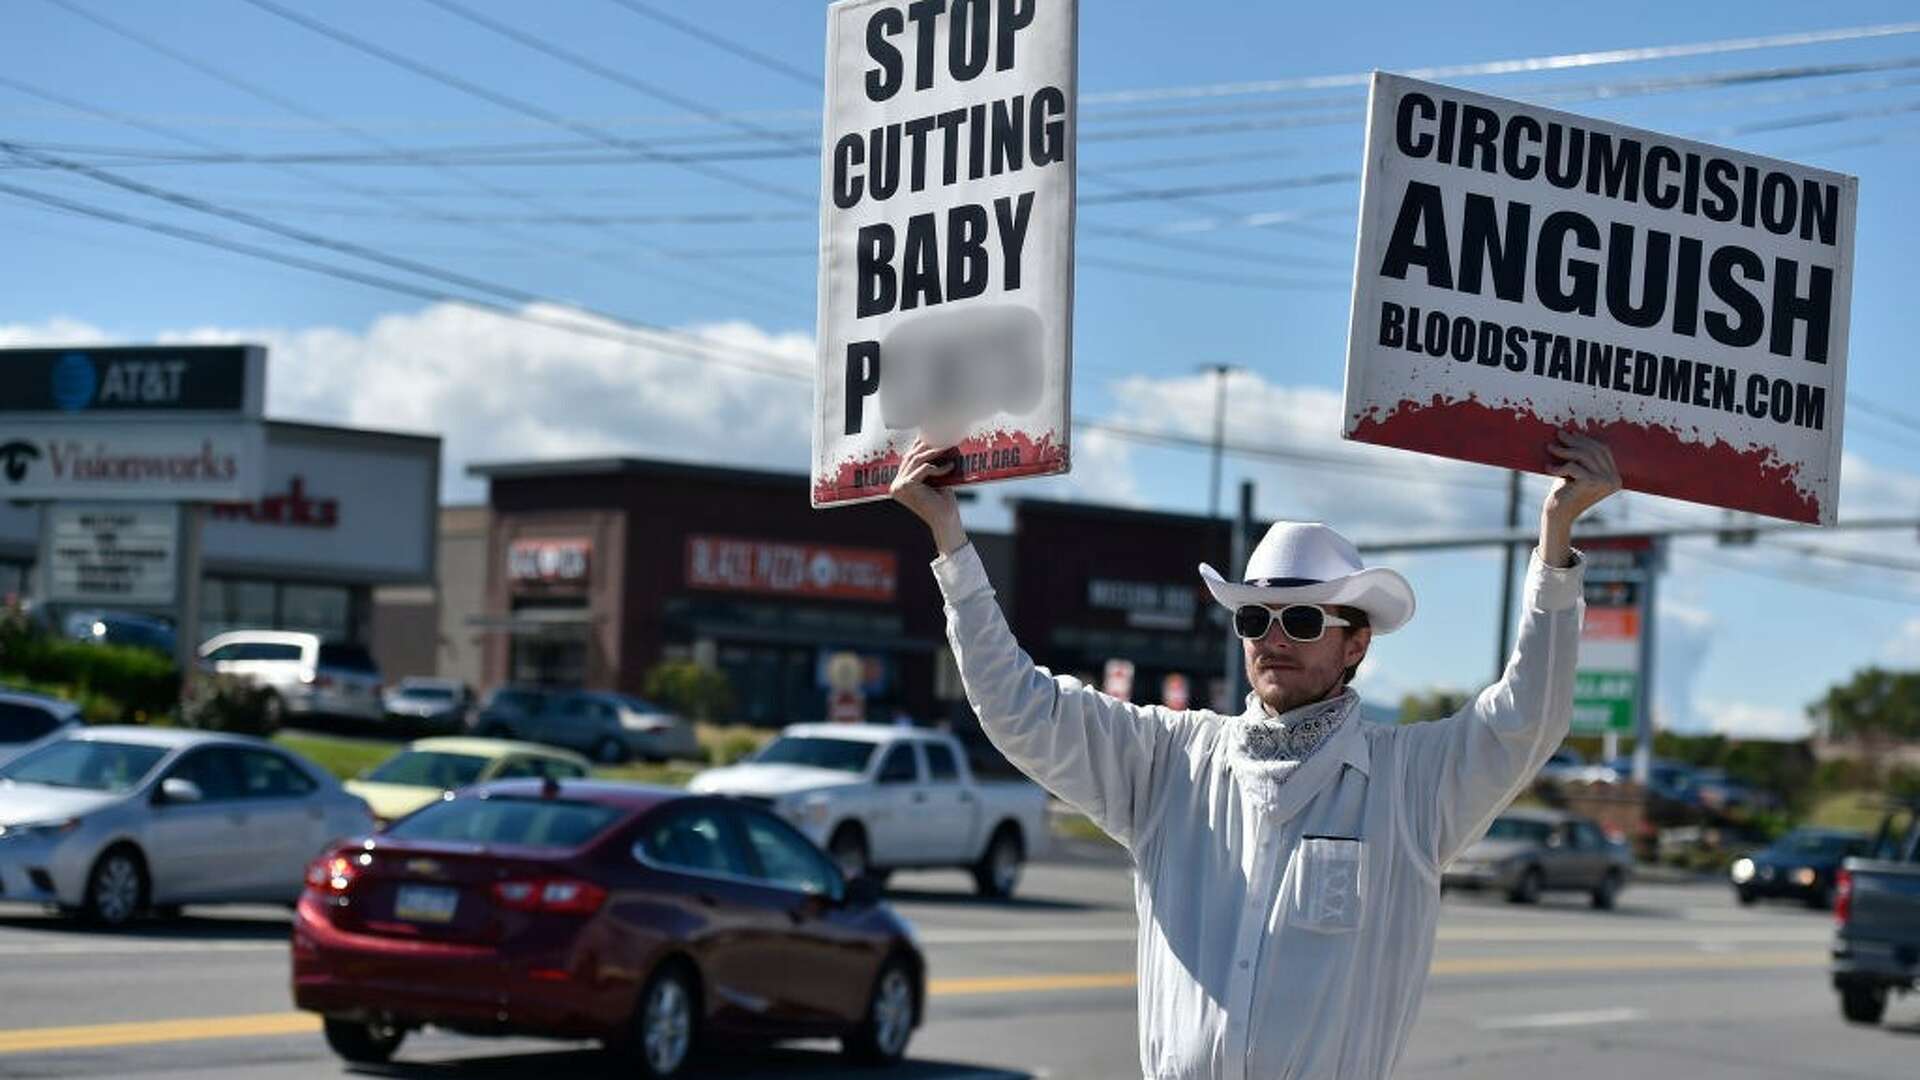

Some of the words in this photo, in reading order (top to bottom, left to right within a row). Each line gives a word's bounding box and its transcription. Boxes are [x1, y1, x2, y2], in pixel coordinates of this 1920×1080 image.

[864, 0, 1036, 102] STOP
[832, 86, 1066, 209] CUTTING
[1396, 92, 1840, 247] CIRCUMCISION
[857, 190, 1036, 319] BABY
[1379, 179, 1834, 365] ANGUISH
[102, 360, 185, 400] AT&T
[1378, 301, 1826, 431] BLOODSTAINEDMEN.COM
[48, 438, 237, 482] Visionworks
